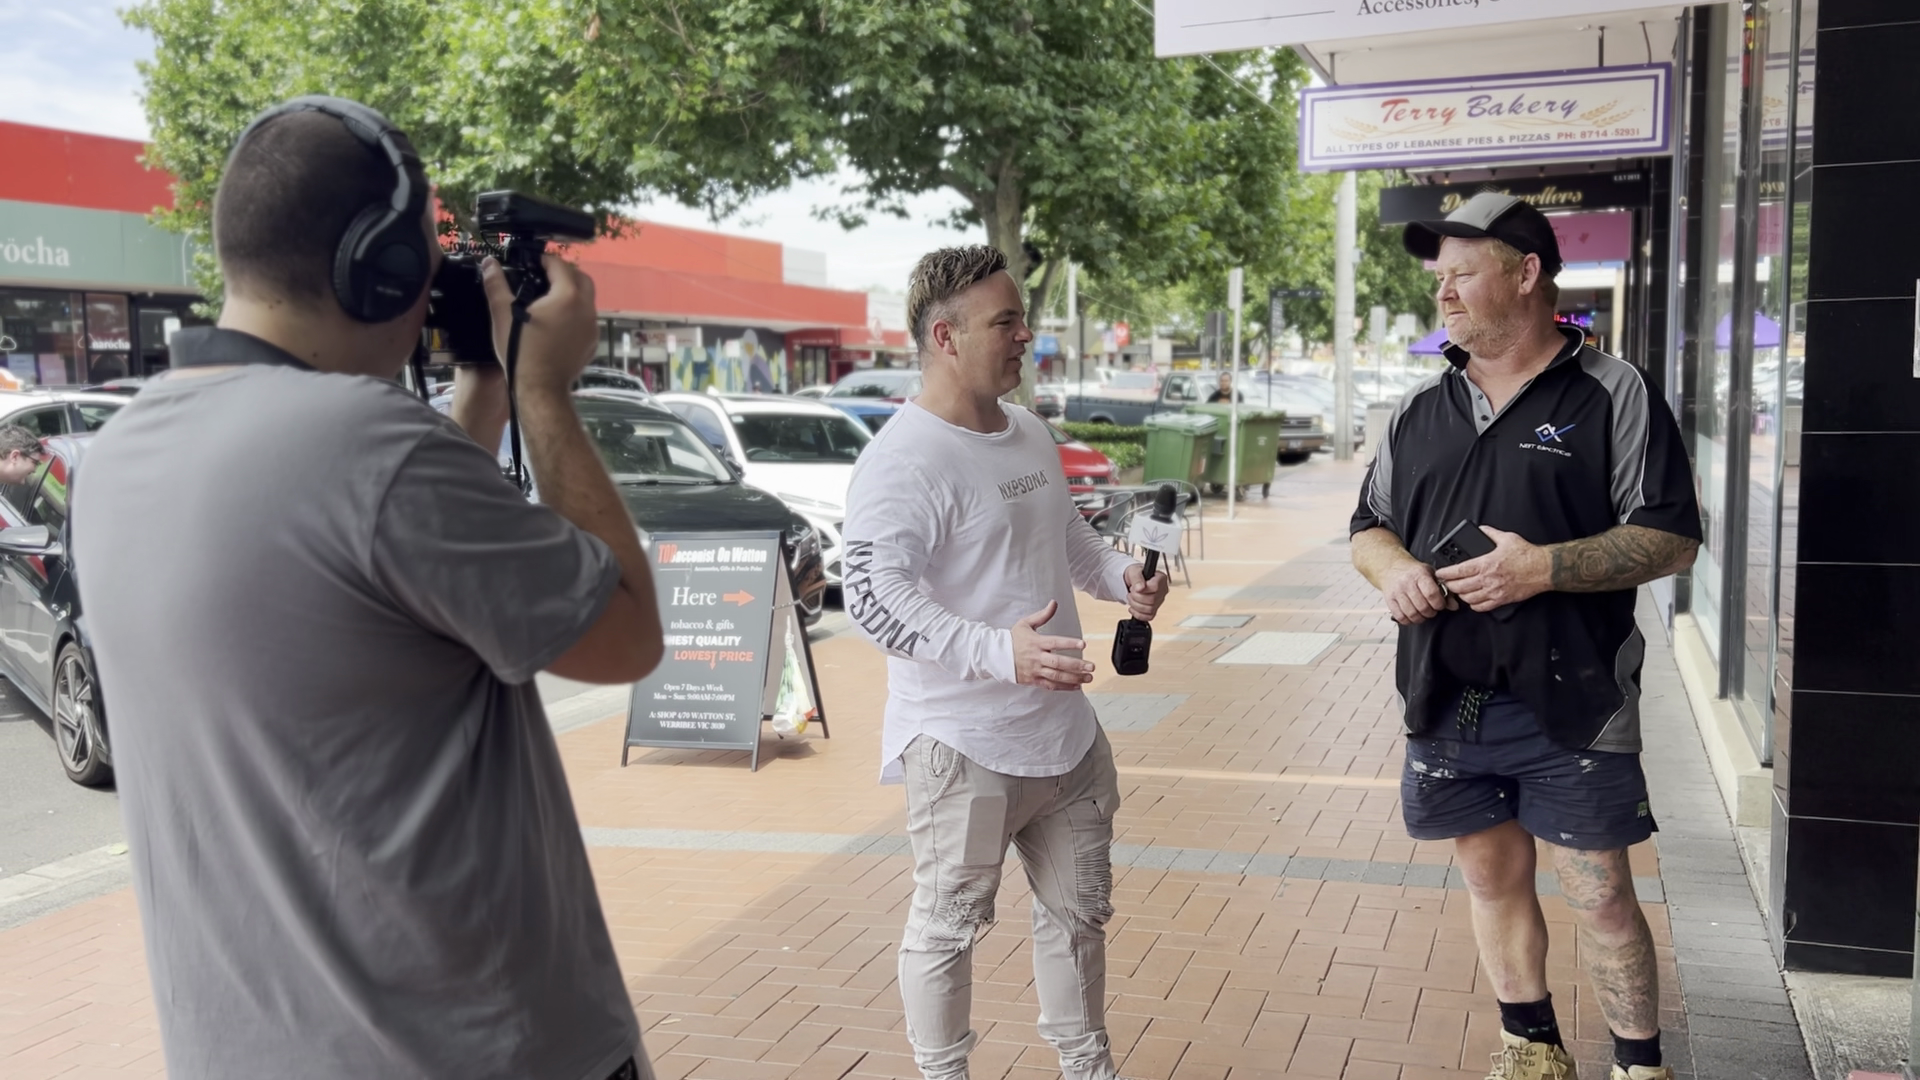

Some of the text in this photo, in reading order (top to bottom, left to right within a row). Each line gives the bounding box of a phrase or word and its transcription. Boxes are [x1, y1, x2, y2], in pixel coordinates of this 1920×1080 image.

[1381, 93, 1579, 126] Terry Bakery
[1325, 144, 1345, 154] ALL
[1348, 141, 1383, 152] TYPES
[1386, 140, 1400, 150] OF
[1404, 137, 1463, 149] LEBANESE
[1467, 135, 1493, 145] PIES
[1497, 135, 1505, 144] &
[1509, 132, 1551, 143] PIZZAS
[1580, 129, 1608, 139] 8714
[0, 236, 70, 267] öcha
[717, 546, 731, 563] On
[731, 546, 767, 563] Watton
[671, 586, 717, 606] Here
[671, 619, 735, 632] tobacco & gifts
[695, 635, 742, 647] QUALITY
[674, 650, 754, 662] LOWEST PRICE
[663, 683, 681, 692] Open
[681, 683, 685, 691] 7
[706, 683, 724, 692] Week
[657, 711, 677, 719] SHOP
[691, 712, 725, 720] WATTON
